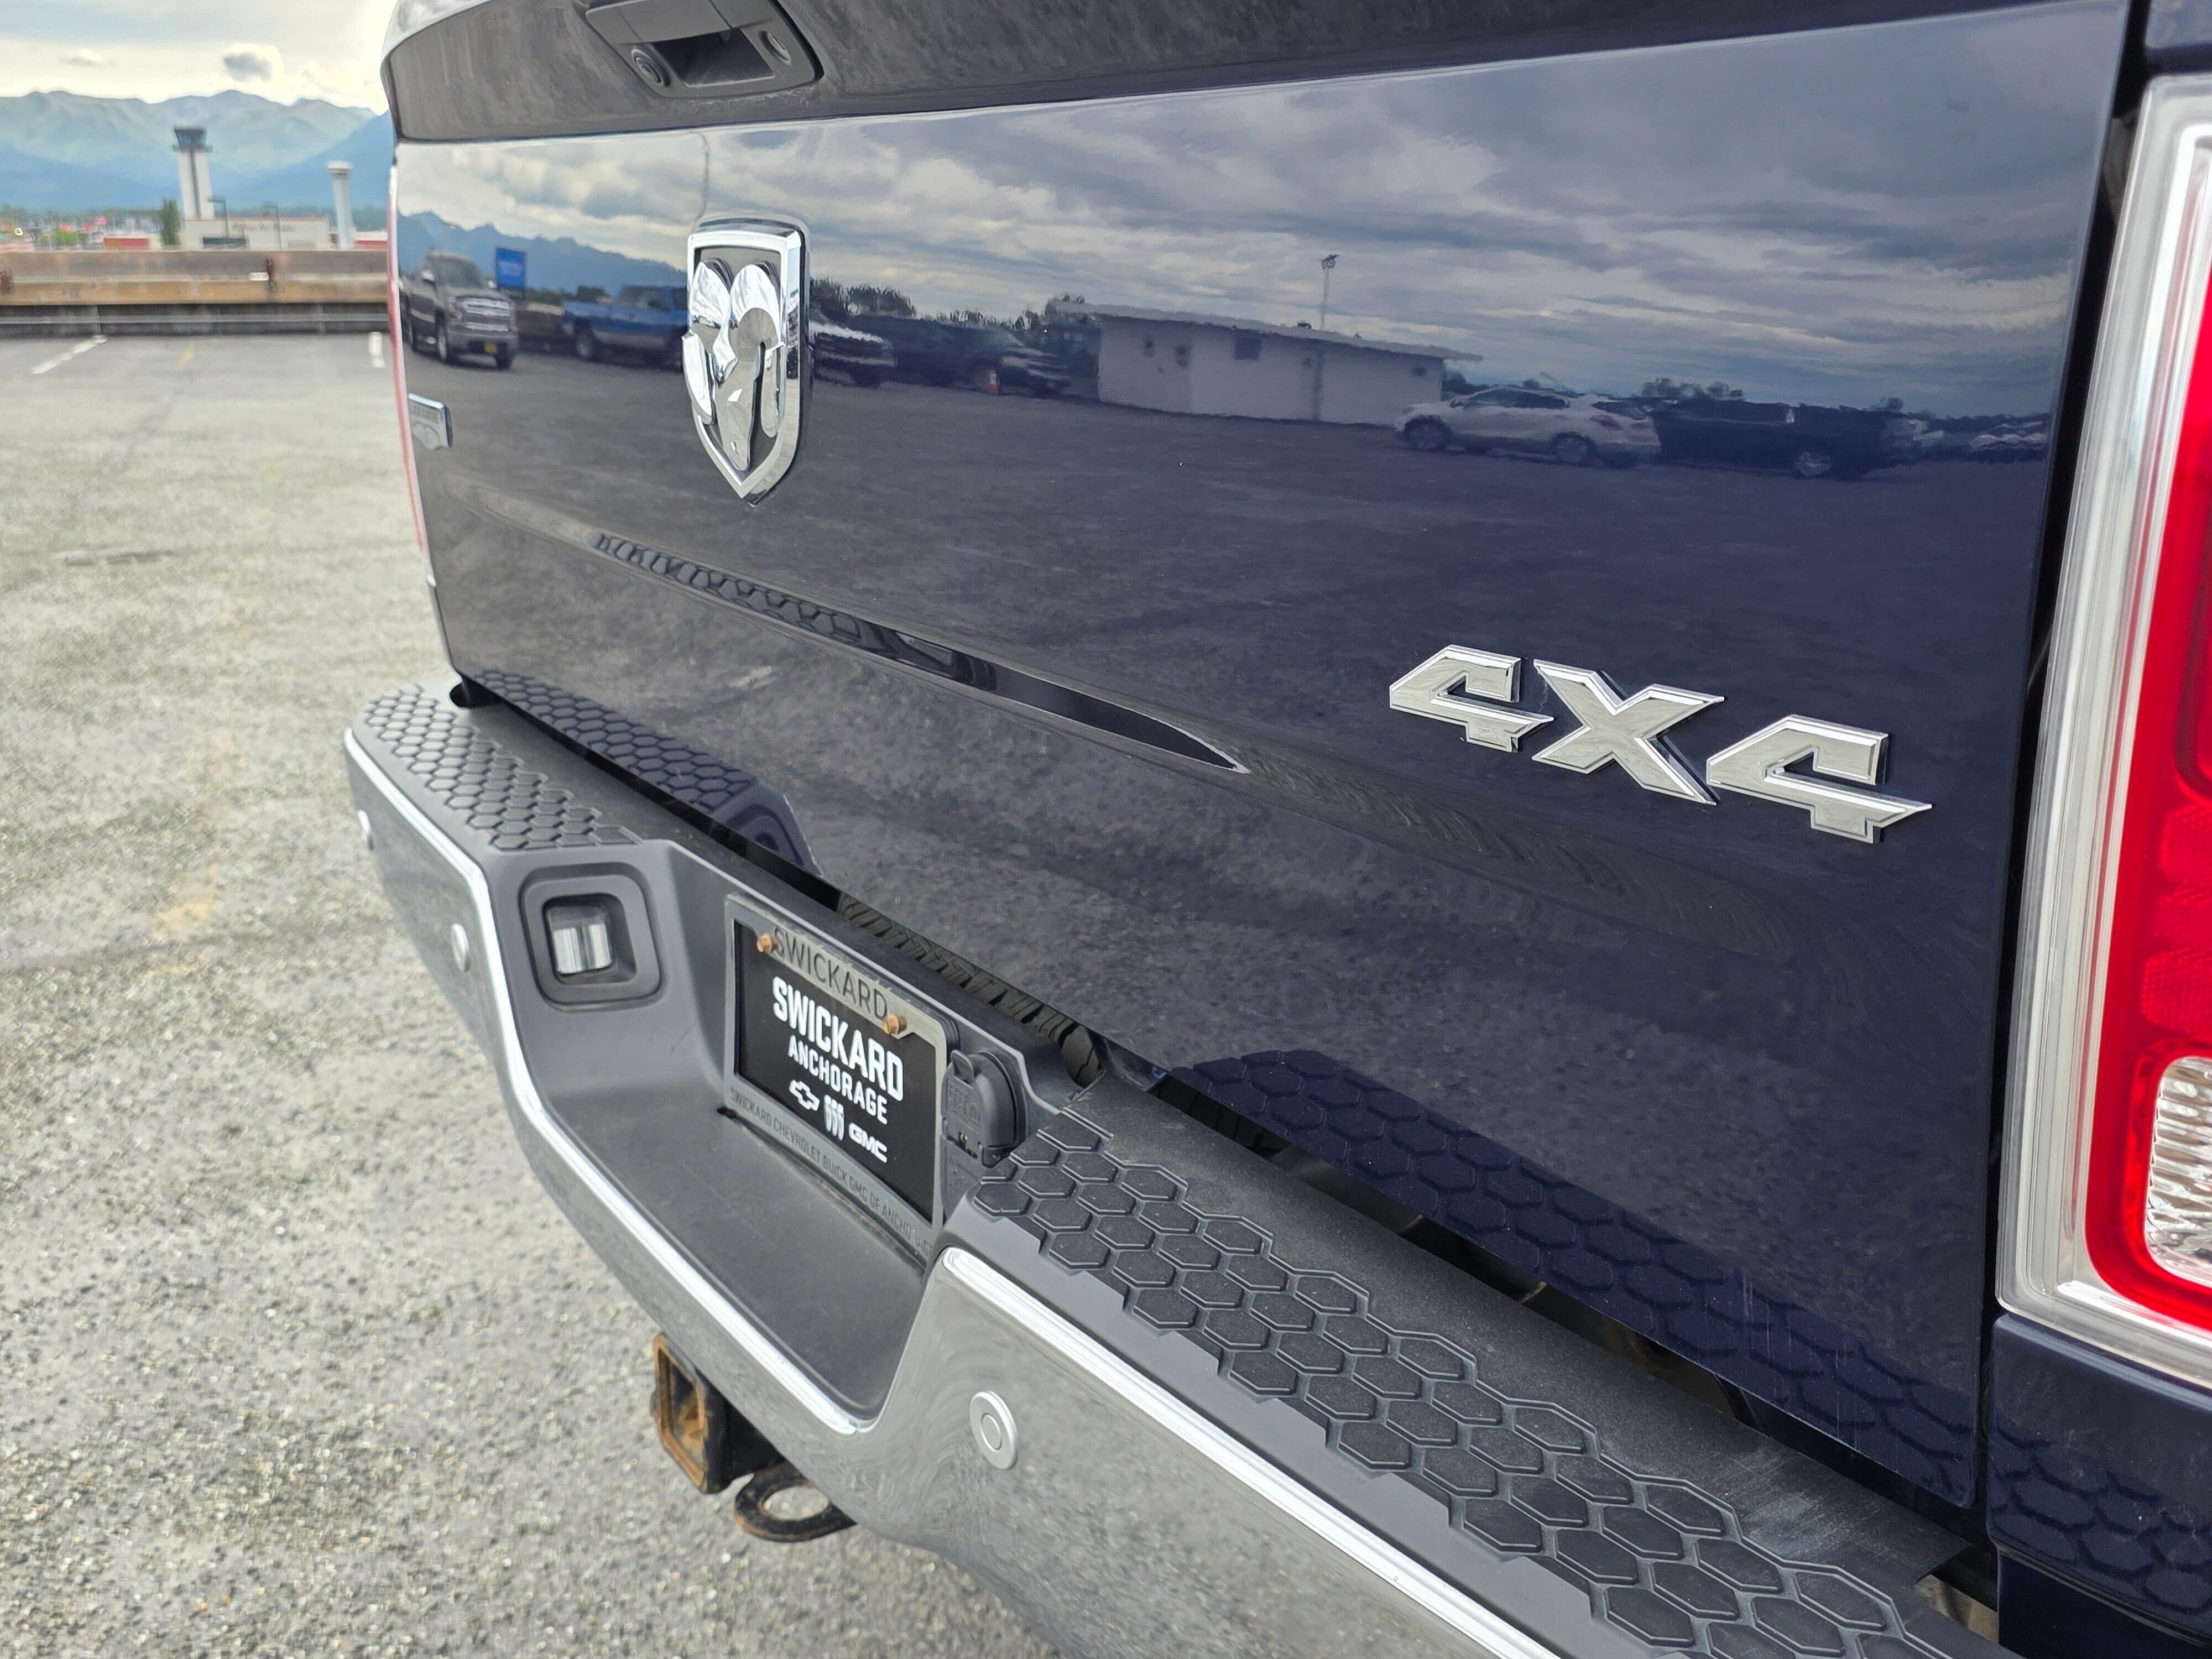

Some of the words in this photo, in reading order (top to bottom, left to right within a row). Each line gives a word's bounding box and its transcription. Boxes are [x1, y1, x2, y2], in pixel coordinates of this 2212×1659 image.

[1390, 644, 1933, 843] 4X4
[774, 927, 888, 1020] SWICKARD
[773, 976, 904, 1102] SWICKARD
[788, 1035, 888, 1125] ANCHORAGE
[730, 1087, 772, 1126] SWICKARD
[774, 1117, 821, 1162] CHEVROLET
[822, 1155, 847, 1186] BUICK
[849, 1176, 868, 1202] GMC
[870, 1193, 880, 1213] OF
[881, 1204, 934, 1259] ANCHOAG
[848, 1122, 888, 1163] GMC
